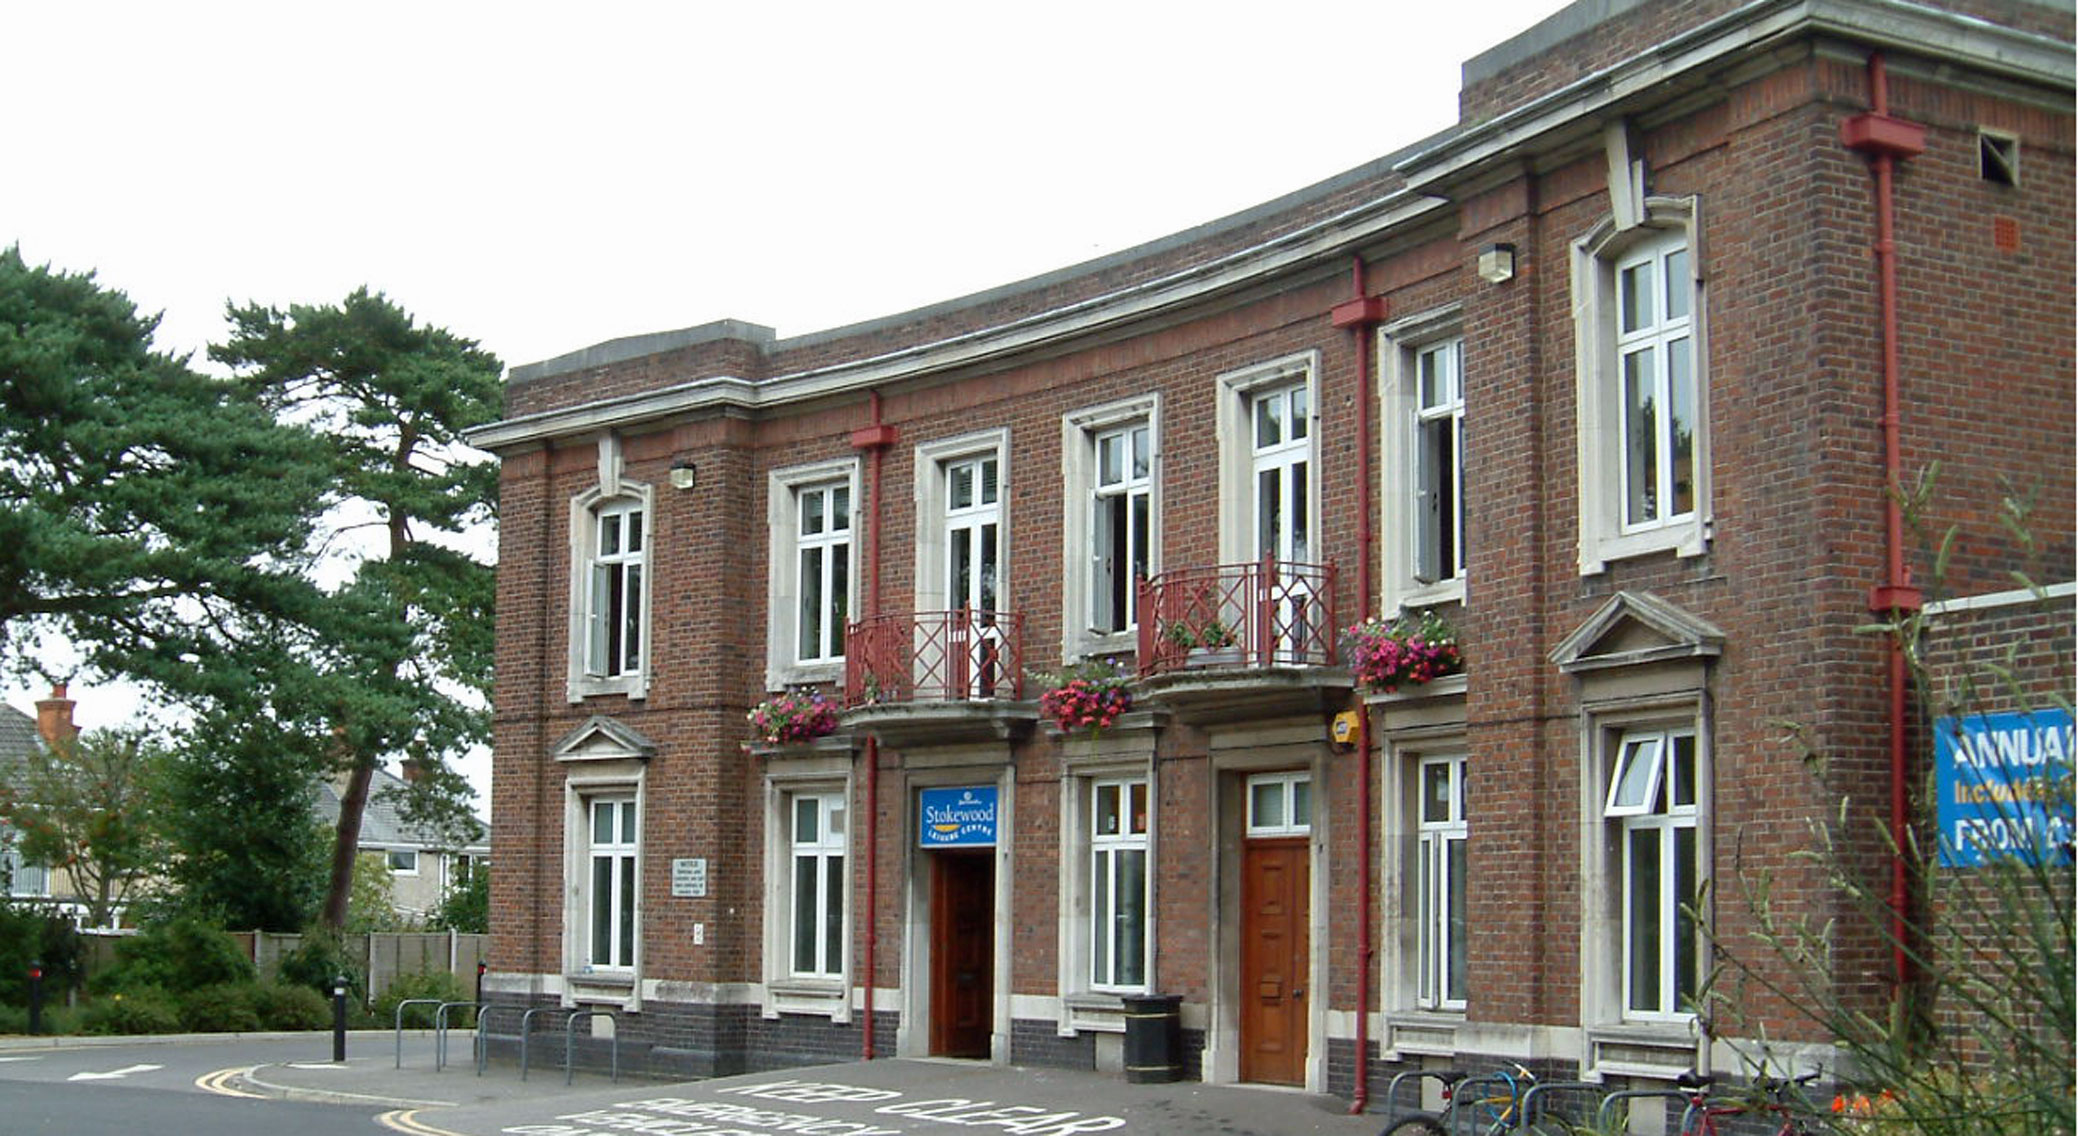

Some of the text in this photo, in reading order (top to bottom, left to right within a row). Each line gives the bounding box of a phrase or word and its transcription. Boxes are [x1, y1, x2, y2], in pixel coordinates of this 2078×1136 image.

[926, 803, 994, 824] Stokewood
[928, 824, 993, 841] LEISURE CENTRE
[612, 1098, 901, 1136] EMERGENCY
[717, 1080, 1127, 1136] KEEP CLEAR
